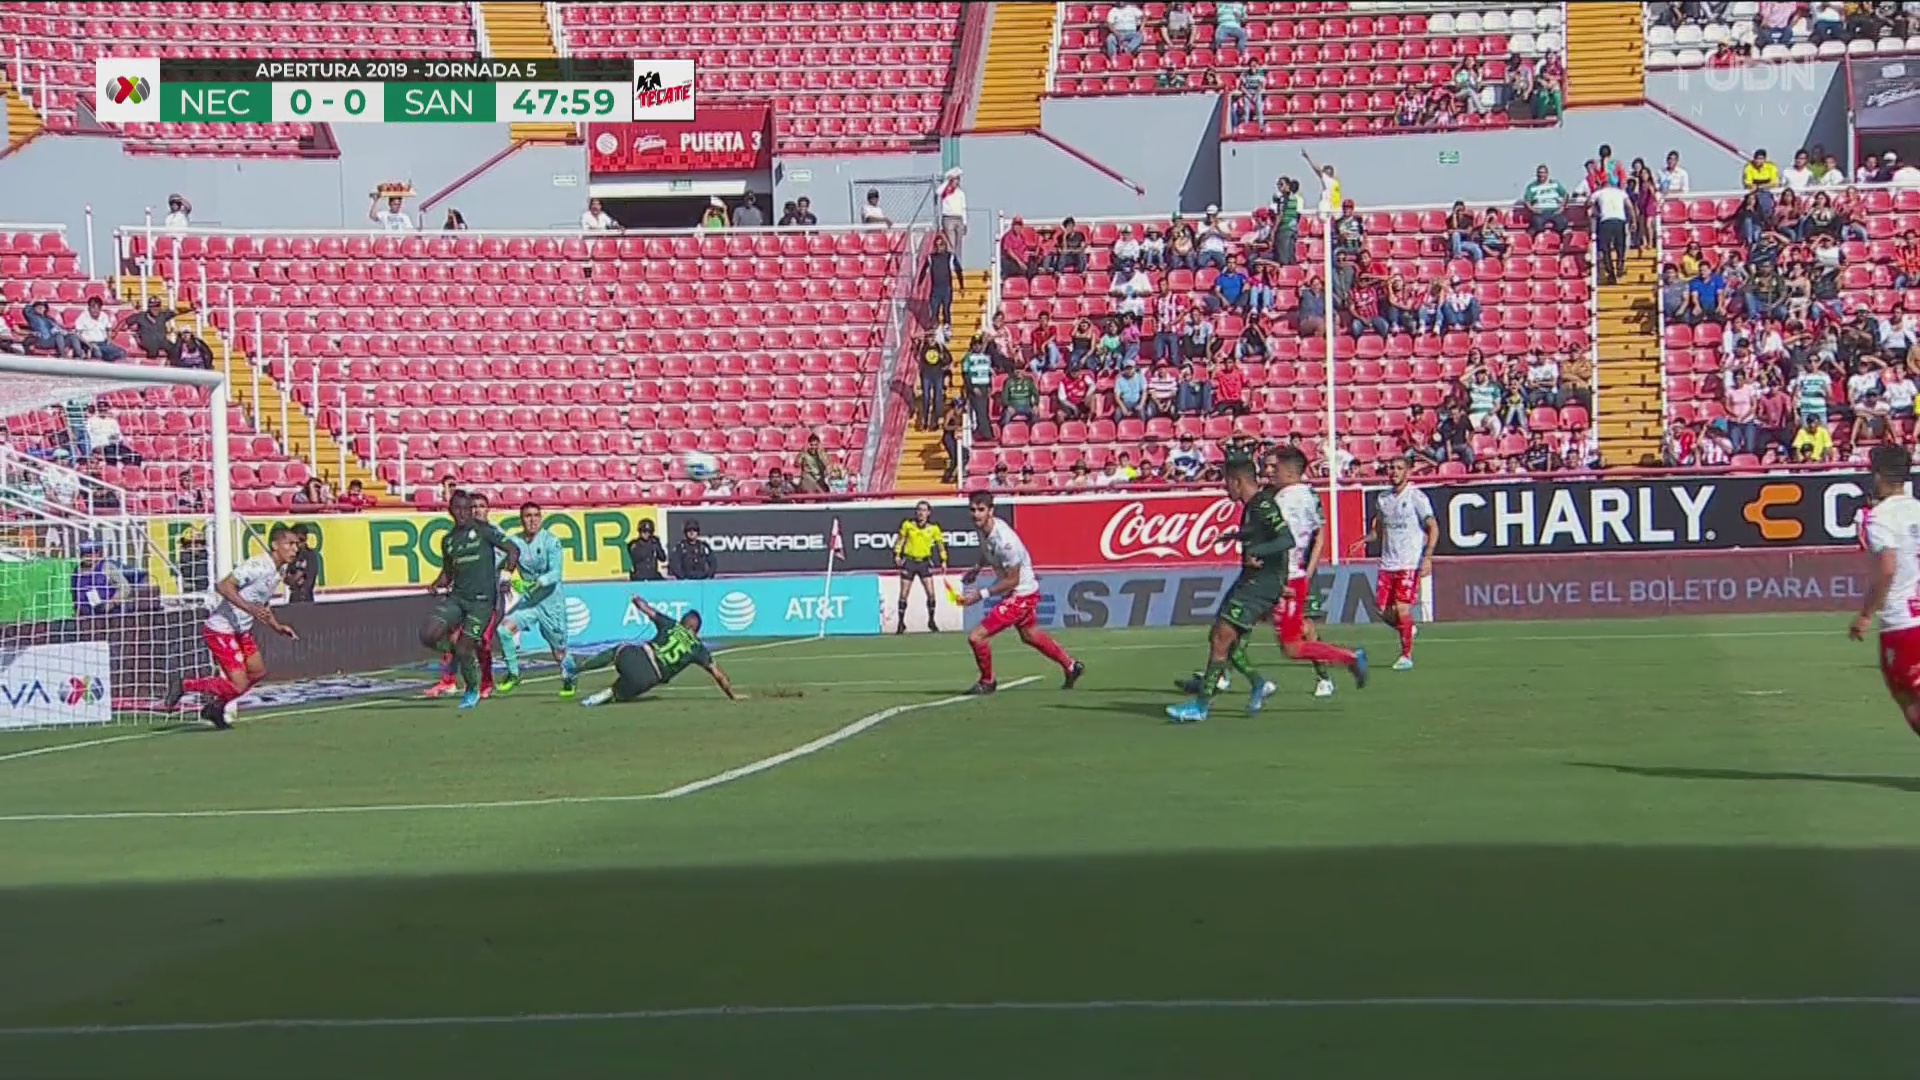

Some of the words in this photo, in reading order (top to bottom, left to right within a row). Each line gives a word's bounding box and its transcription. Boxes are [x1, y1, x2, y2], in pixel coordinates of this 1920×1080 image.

[680, 131, 745, 152] PUERTA
[751, 131, 762, 151] 3
[854, 531, 980, 549] POWADE
[1100, 498, 1243, 560] Coca-Co
[1465, 582, 1580, 606] INCLUYE
[1590, 580, 1621, 603] EL
[1630, 578, 1737, 602] BOLETO
[1746, 576, 1822, 599] PARA
[1830, 575, 1863, 598] EL
[785, 596, 849, 620] AT&T
